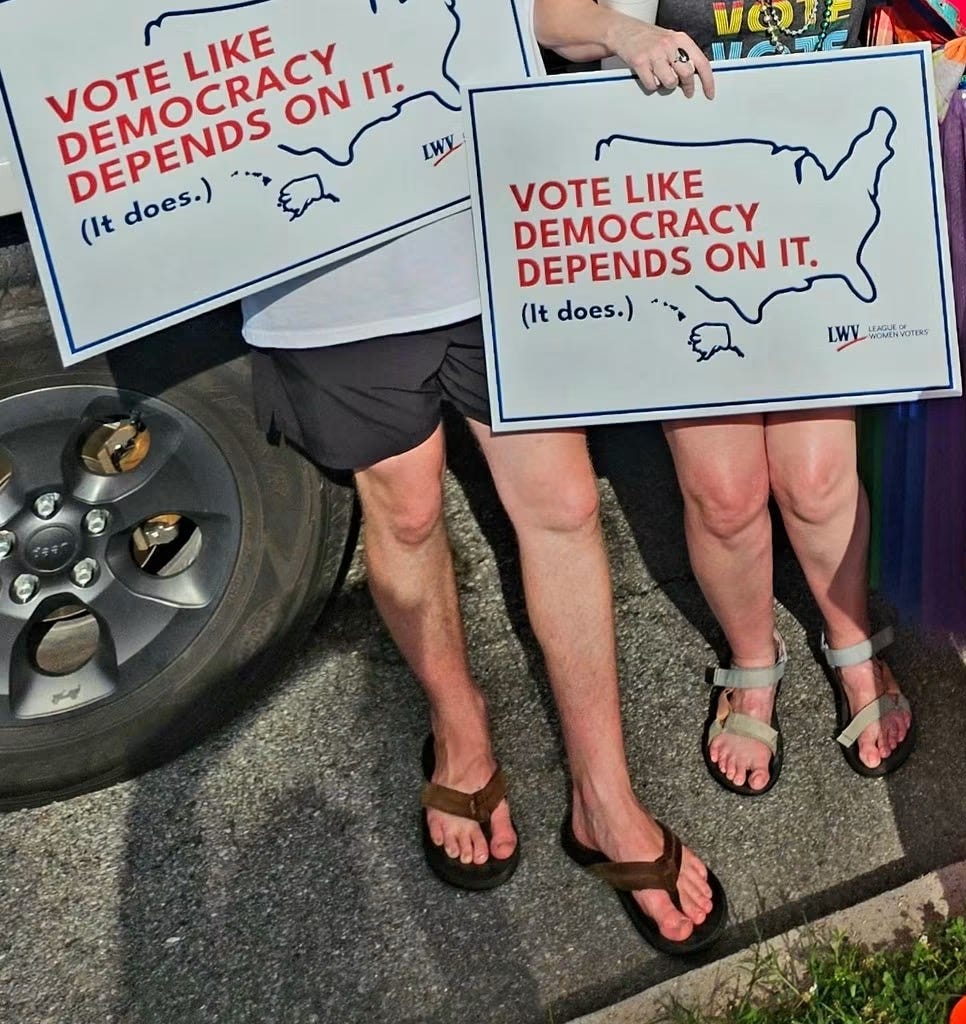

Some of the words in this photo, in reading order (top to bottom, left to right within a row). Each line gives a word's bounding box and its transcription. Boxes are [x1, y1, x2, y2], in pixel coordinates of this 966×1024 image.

[46, 59, 170, 124] VOTE
[184, 26, 275, 81] LIKE
[57, 44, 337, 165] DEMOCRACY
[67, 109, 271, 204] DEPENDS
[285, 82, 351, 126] ON
[364, 63, 405, 100] IT.
[422, 134, 454, 160] LWV
[81, 215, 115, 246] (It
[125, 177, 213, 225] does.)
[510, 177, 612, 212] VOTE
[626, 169, 703, 204] LIKE
[514, 203, 759, 251] DEMOCRACY
[518, 246, 692, 288] DEPENDS
[705, 241, 766, 273] ON
[780, 236, 818, 268] IT.
[521, 302, 549, 330] (It
[557, 295, 634, 322] does.)
[828, 324, 859, 343] LWV
[868, 323, 896, 332] LEAGUE
[869, 331, 898, 339] WOMEN
